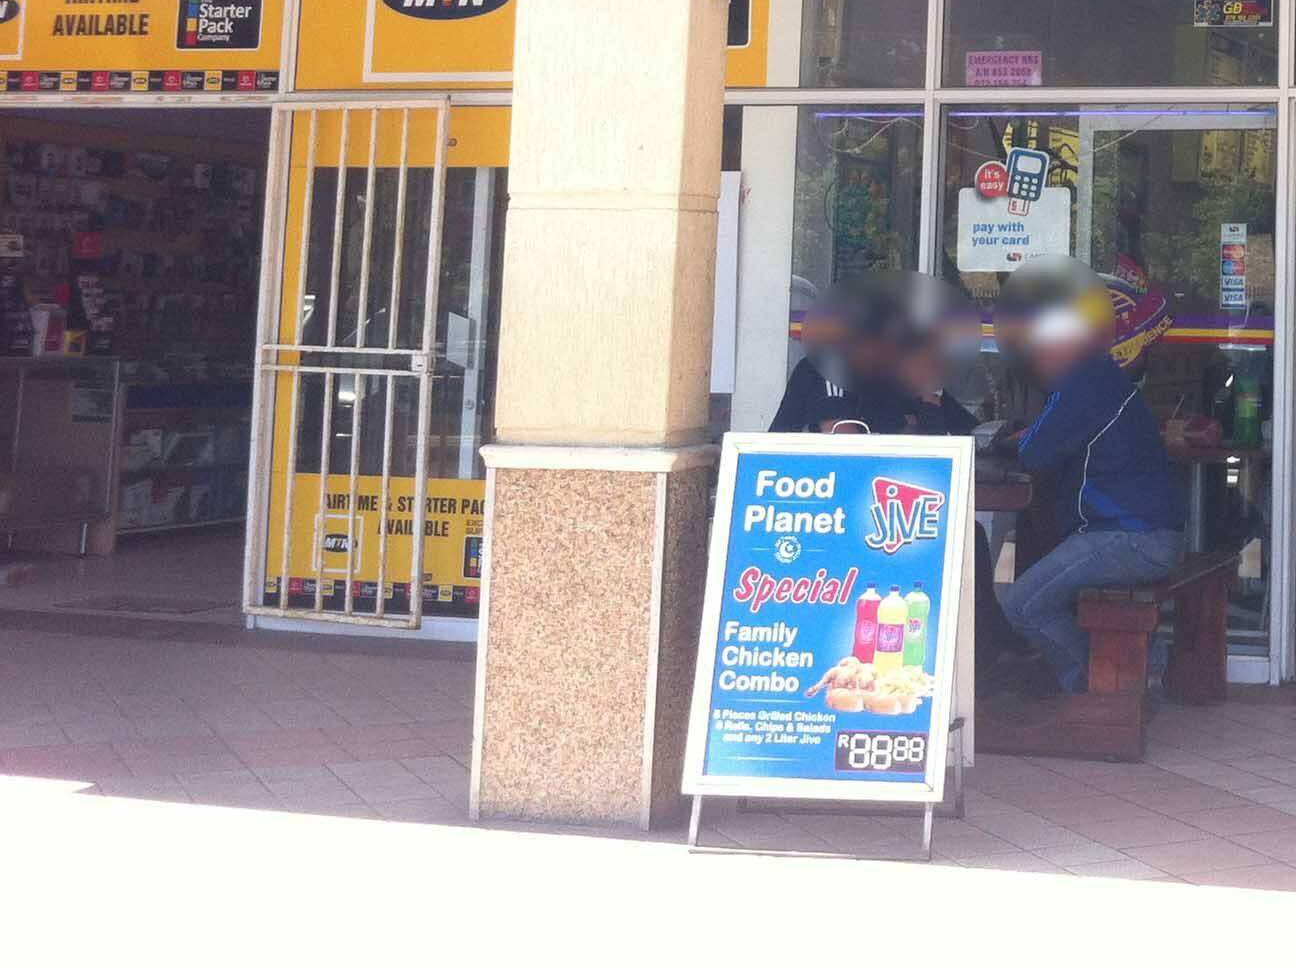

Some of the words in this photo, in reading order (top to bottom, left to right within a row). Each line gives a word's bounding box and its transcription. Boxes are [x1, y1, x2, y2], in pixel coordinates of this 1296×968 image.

[199, 3, 252, 19] Starter
[52, 13, 150, 37] AVAILABLE
[199, 18, 234, 34] Pack
[197, 34, 230, 43] Company
[980, 181, 1004, 192] easy
[973, 223, 995, 234] pay
[996, 221, 1024, 232] with
[972, 237, 999, 246] your
[1002, 235, 1029, 245] card
[756, 470, 836, 499] Food
[743, 504, 846, 535] Planet
[733, 566, 859, 614] Special
[724, 620, 798, 647] Family
[721, 646, 814, 669] Chicken
[719, 670, 799, 693] Combo
[722, 709, 756, 721] Pieces
[758, 710, 793, 722] Grilled
[794, 711, 837, 723] Chicken
[755, 722, 784, 733] Chips
[722, 733, 743, 743] and
[744, 734, 763, 745] any
[764, 734, 772, 744] 2
